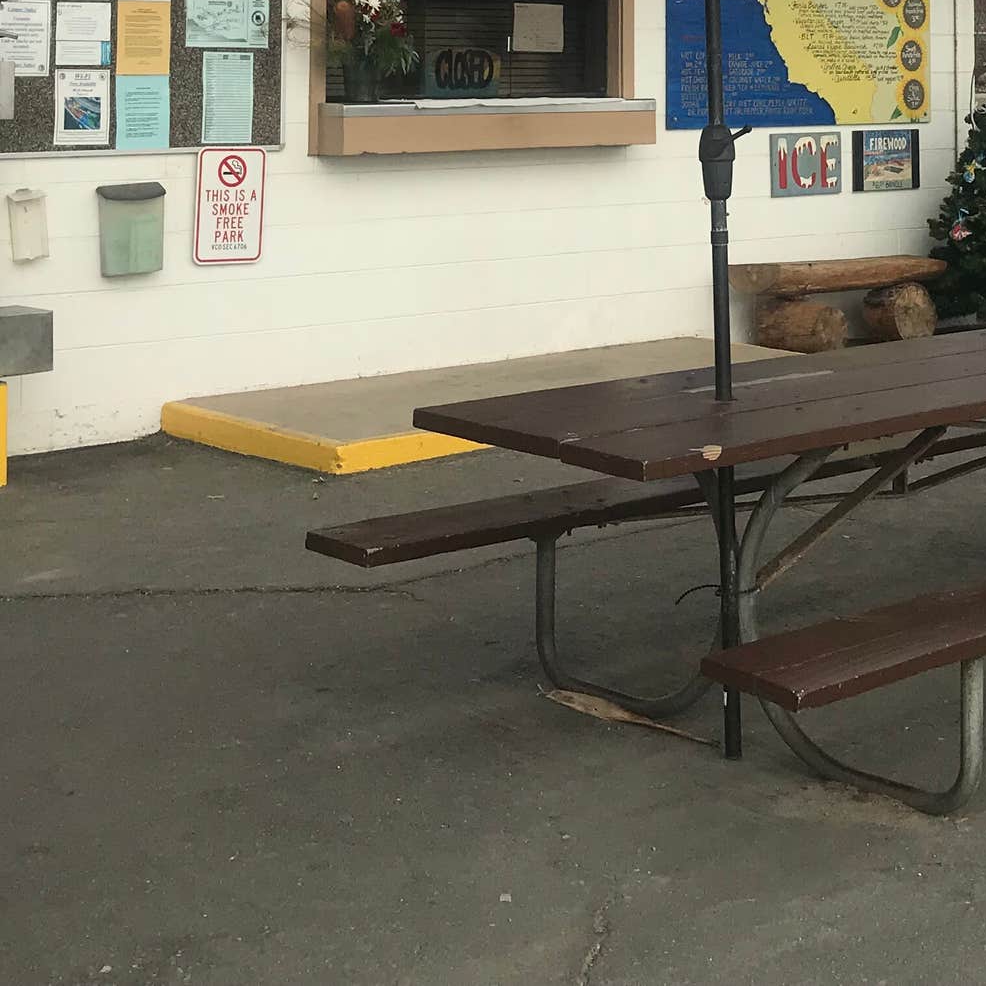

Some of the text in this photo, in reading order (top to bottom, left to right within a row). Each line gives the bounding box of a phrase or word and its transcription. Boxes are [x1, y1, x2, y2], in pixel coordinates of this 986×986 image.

[869, 136, 907, 151] FIREWOOD
[777, 134, 839, 190] ICE
[205, 189, 257, 202] THIS IS A
[212, 203, 249, 216] SMOKE
[216, 216, 244, 229] FREE
[214, 230, 244, 243] PARK
